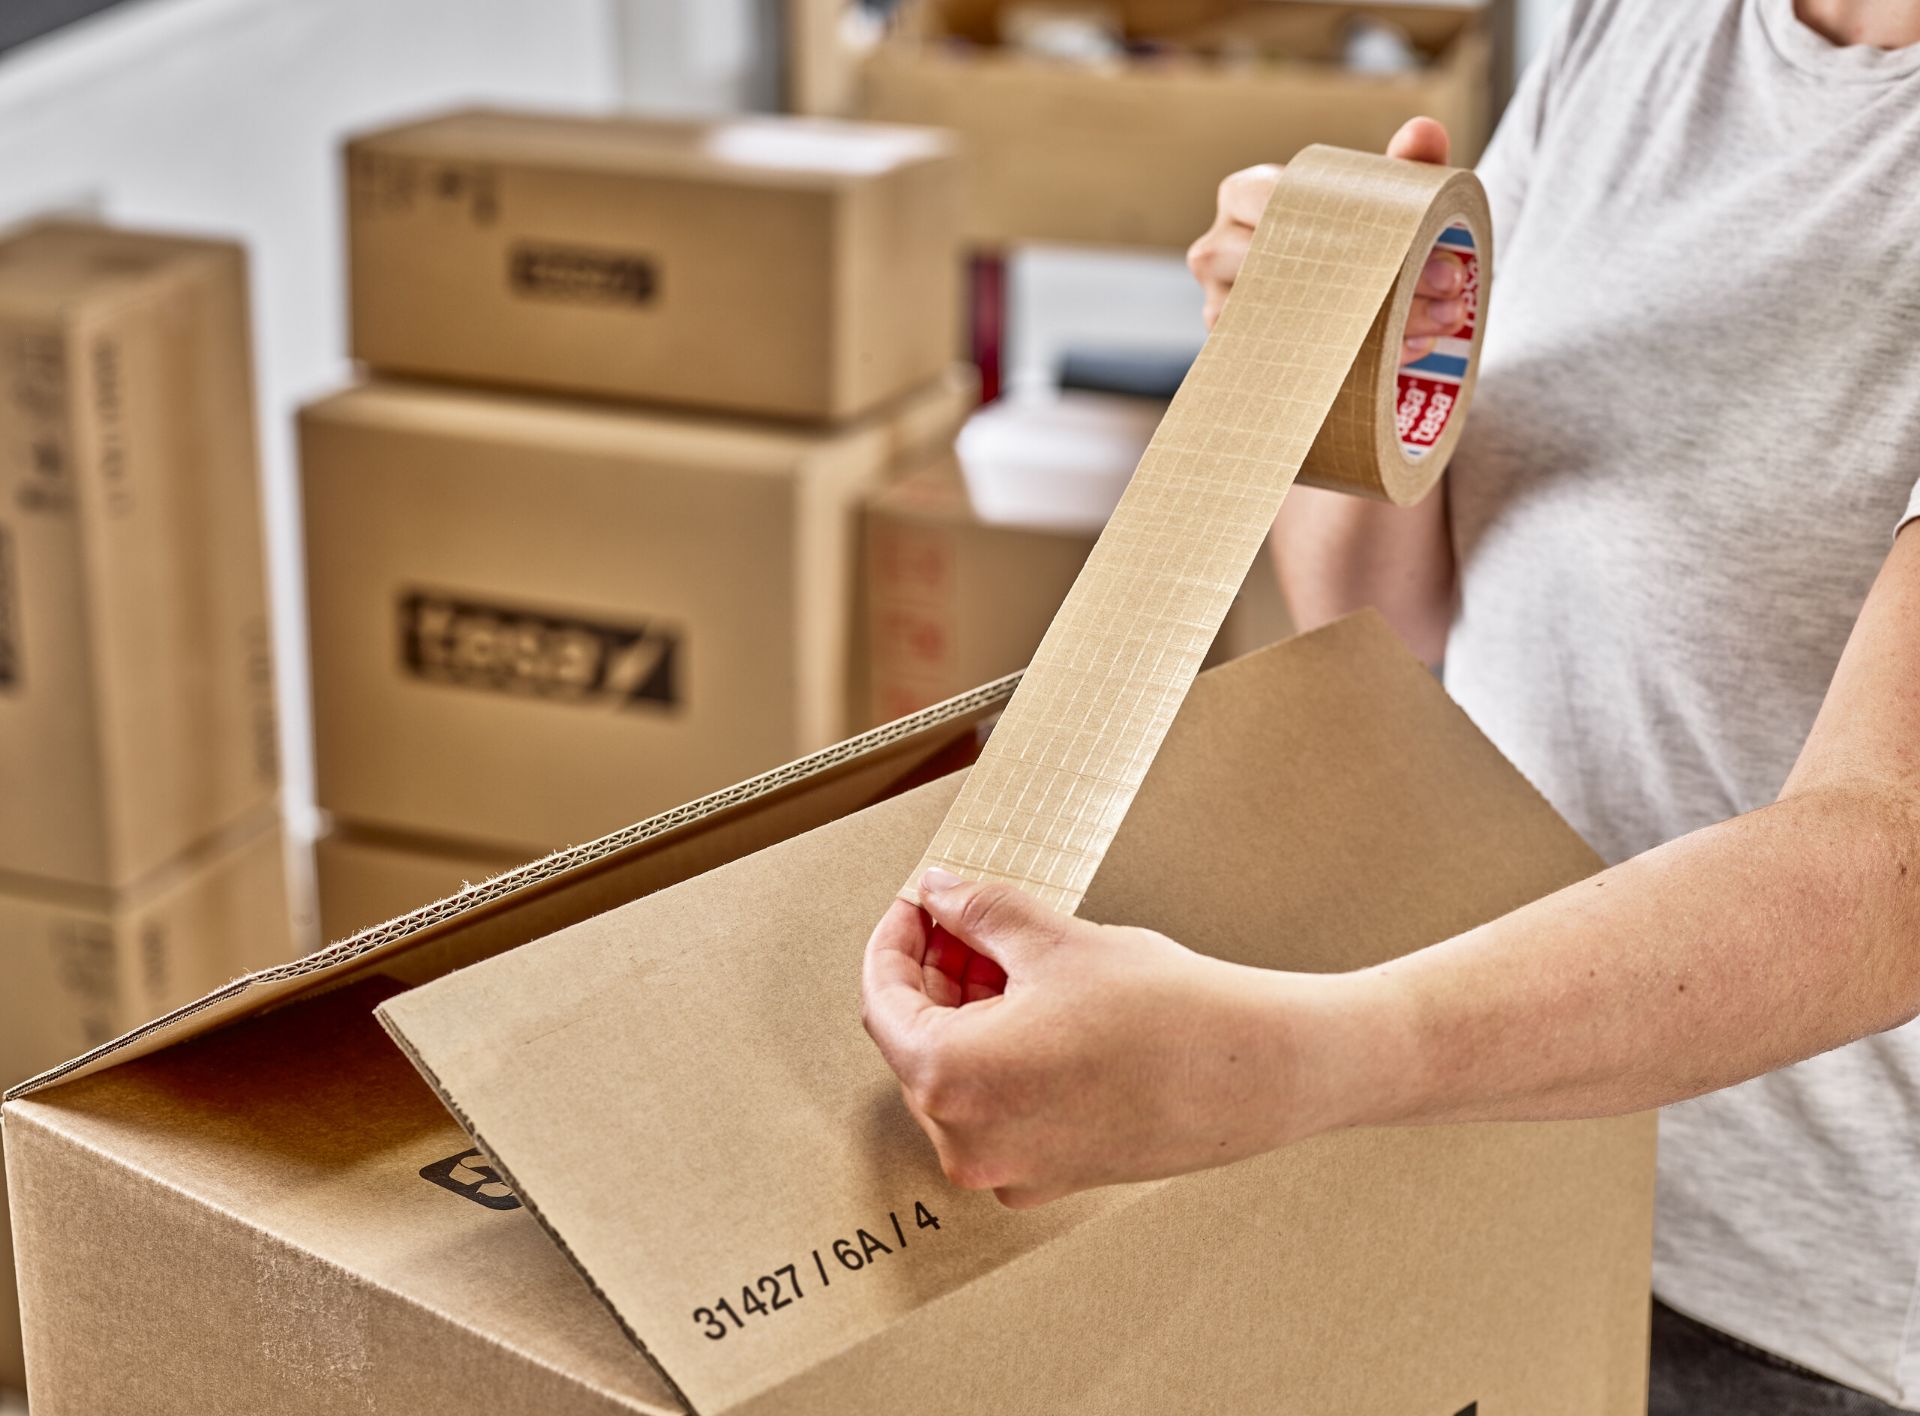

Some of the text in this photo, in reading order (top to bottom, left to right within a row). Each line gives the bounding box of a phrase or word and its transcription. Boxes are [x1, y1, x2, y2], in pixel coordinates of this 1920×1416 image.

[1410, 392, 1453, 442] tesa
[693, 1201, 940, 1340] 31427 / 6A / 4
